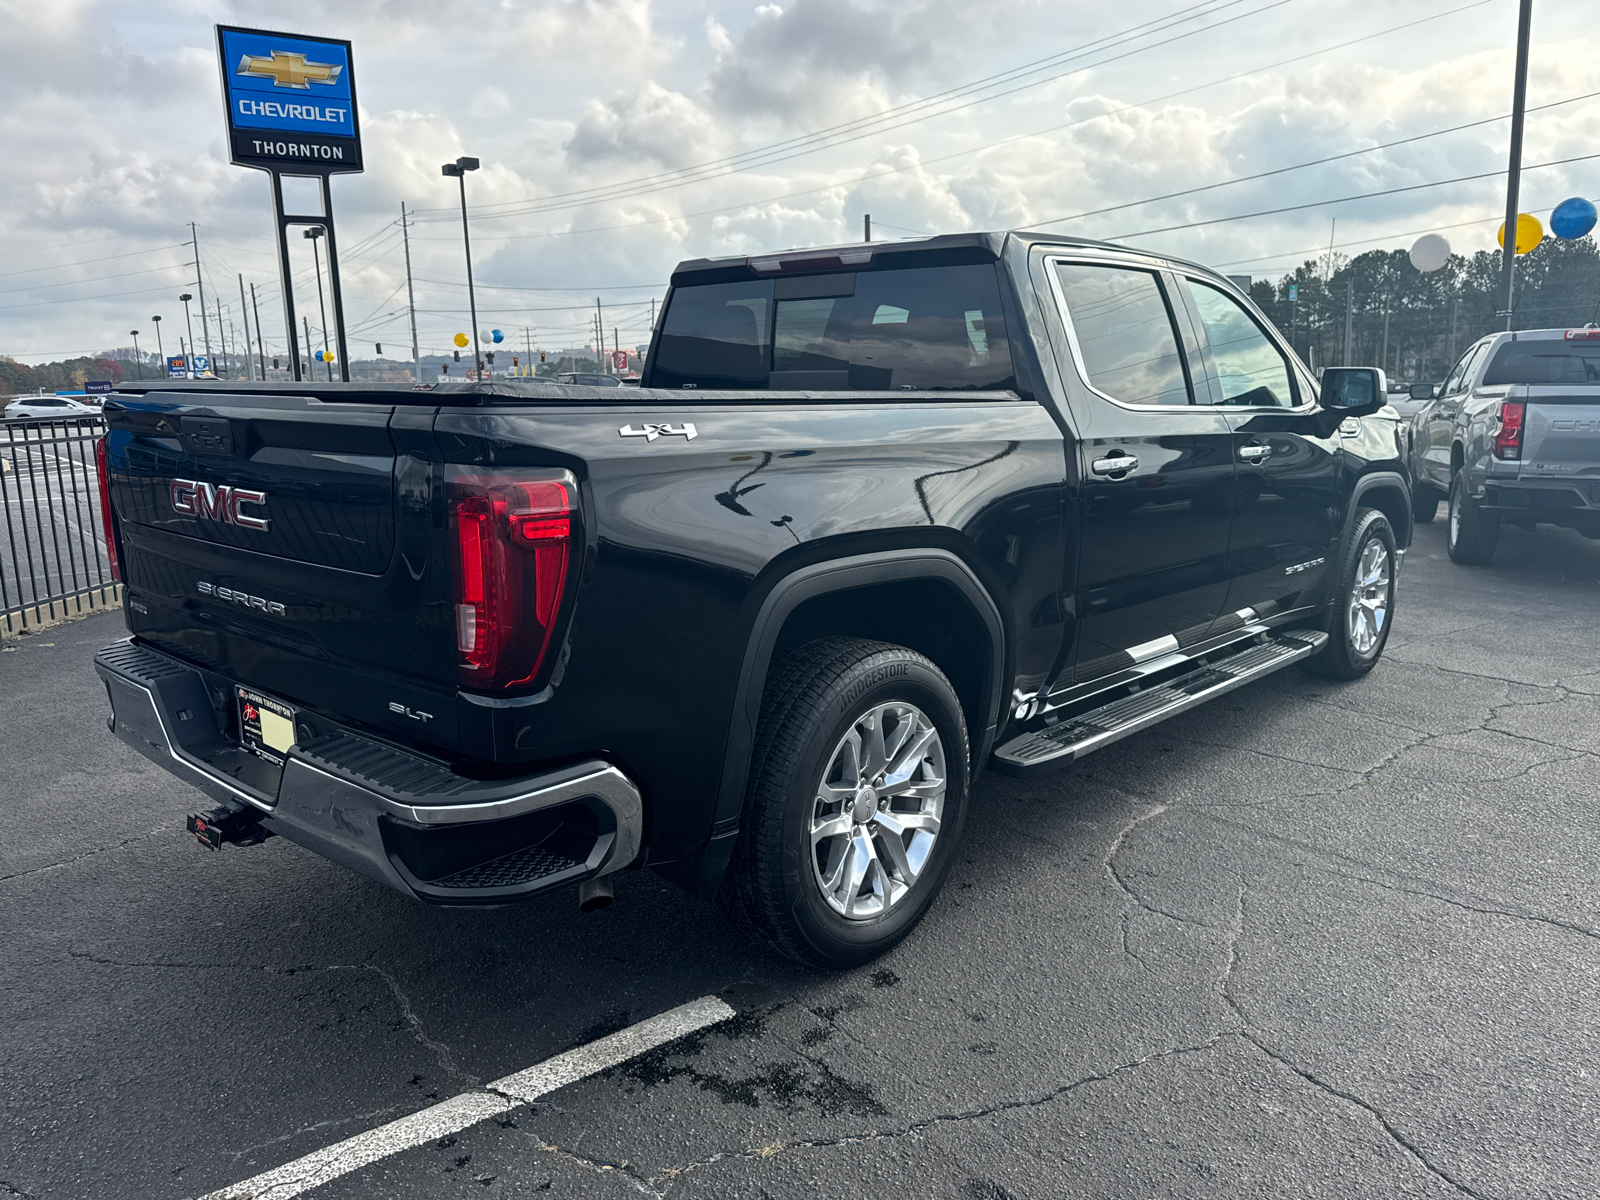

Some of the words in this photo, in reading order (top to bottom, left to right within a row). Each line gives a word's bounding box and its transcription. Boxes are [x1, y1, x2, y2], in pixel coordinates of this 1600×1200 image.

[238, 99, 347, 123] CHEVROLET
[252, 140, 344, 160] THORNTON
[169, 477, 271, 532] GMC
[1285, 557, 1325, 575] SIERRA
[196, 580, 288, 617] SIERRA
[836, 663, 909, 714] BRIDGESTONE
[248, 691, 263, 705] JOHN
[262, 697, 292, 717] THORNTON
[388, 701, 435, 723] SLT
